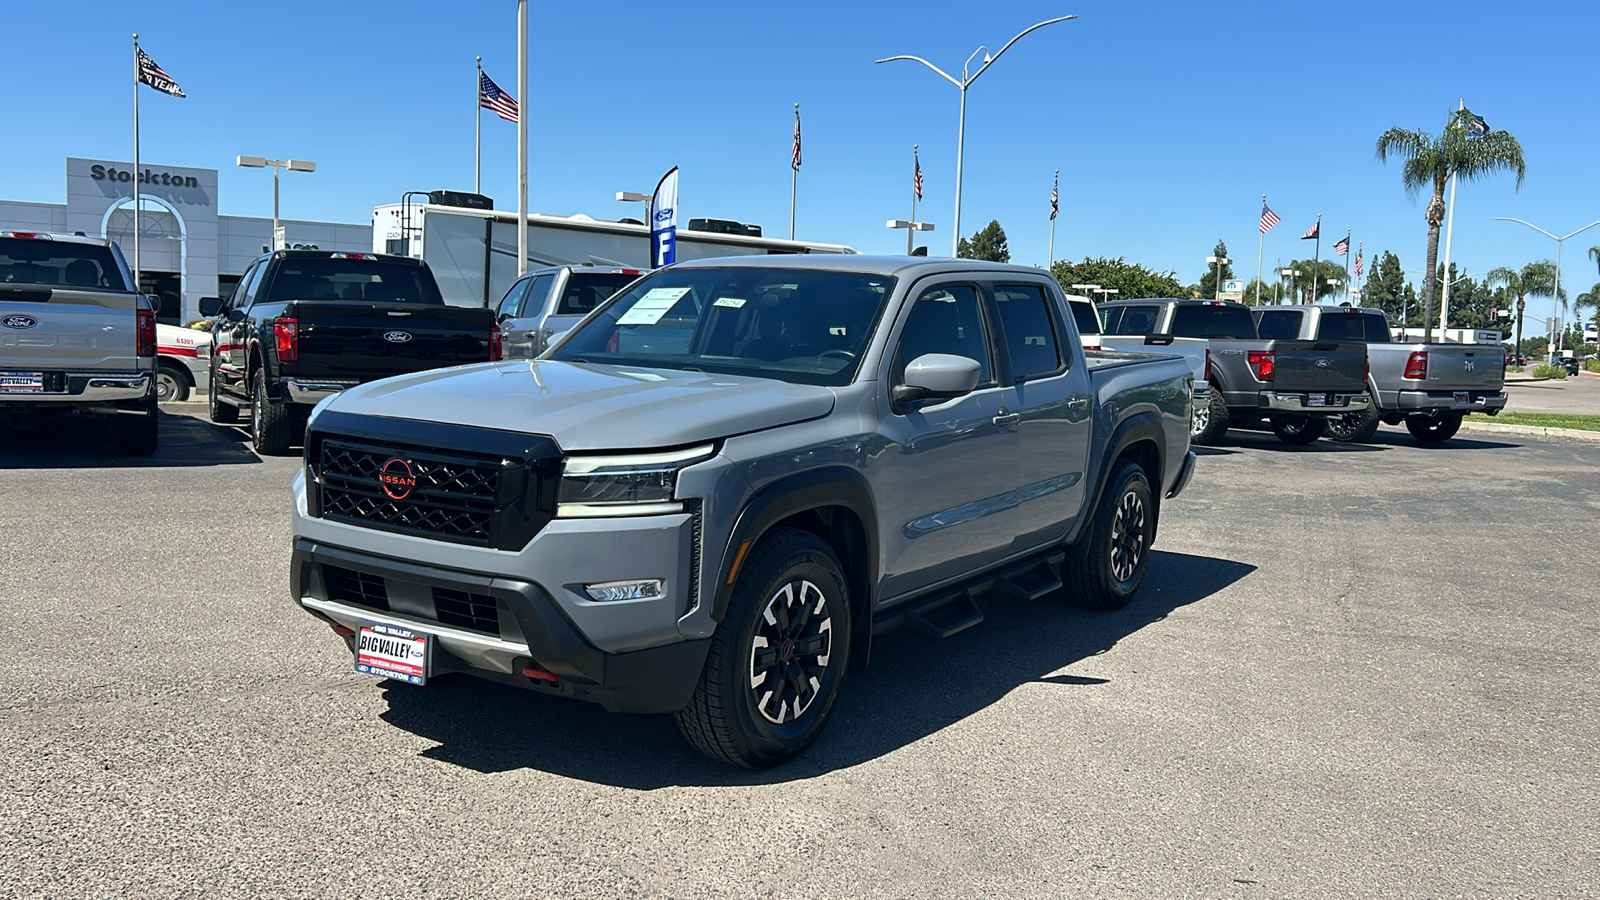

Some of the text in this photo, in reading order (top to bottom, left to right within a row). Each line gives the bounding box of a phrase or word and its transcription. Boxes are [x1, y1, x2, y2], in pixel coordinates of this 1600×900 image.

[6, 315, 32, 327] Ford
[379, 473, 416, 486] NISSAN
[360, 635, 411, 659] BIGVALLEY
[370, 667, 409, 681] STOCKTON
